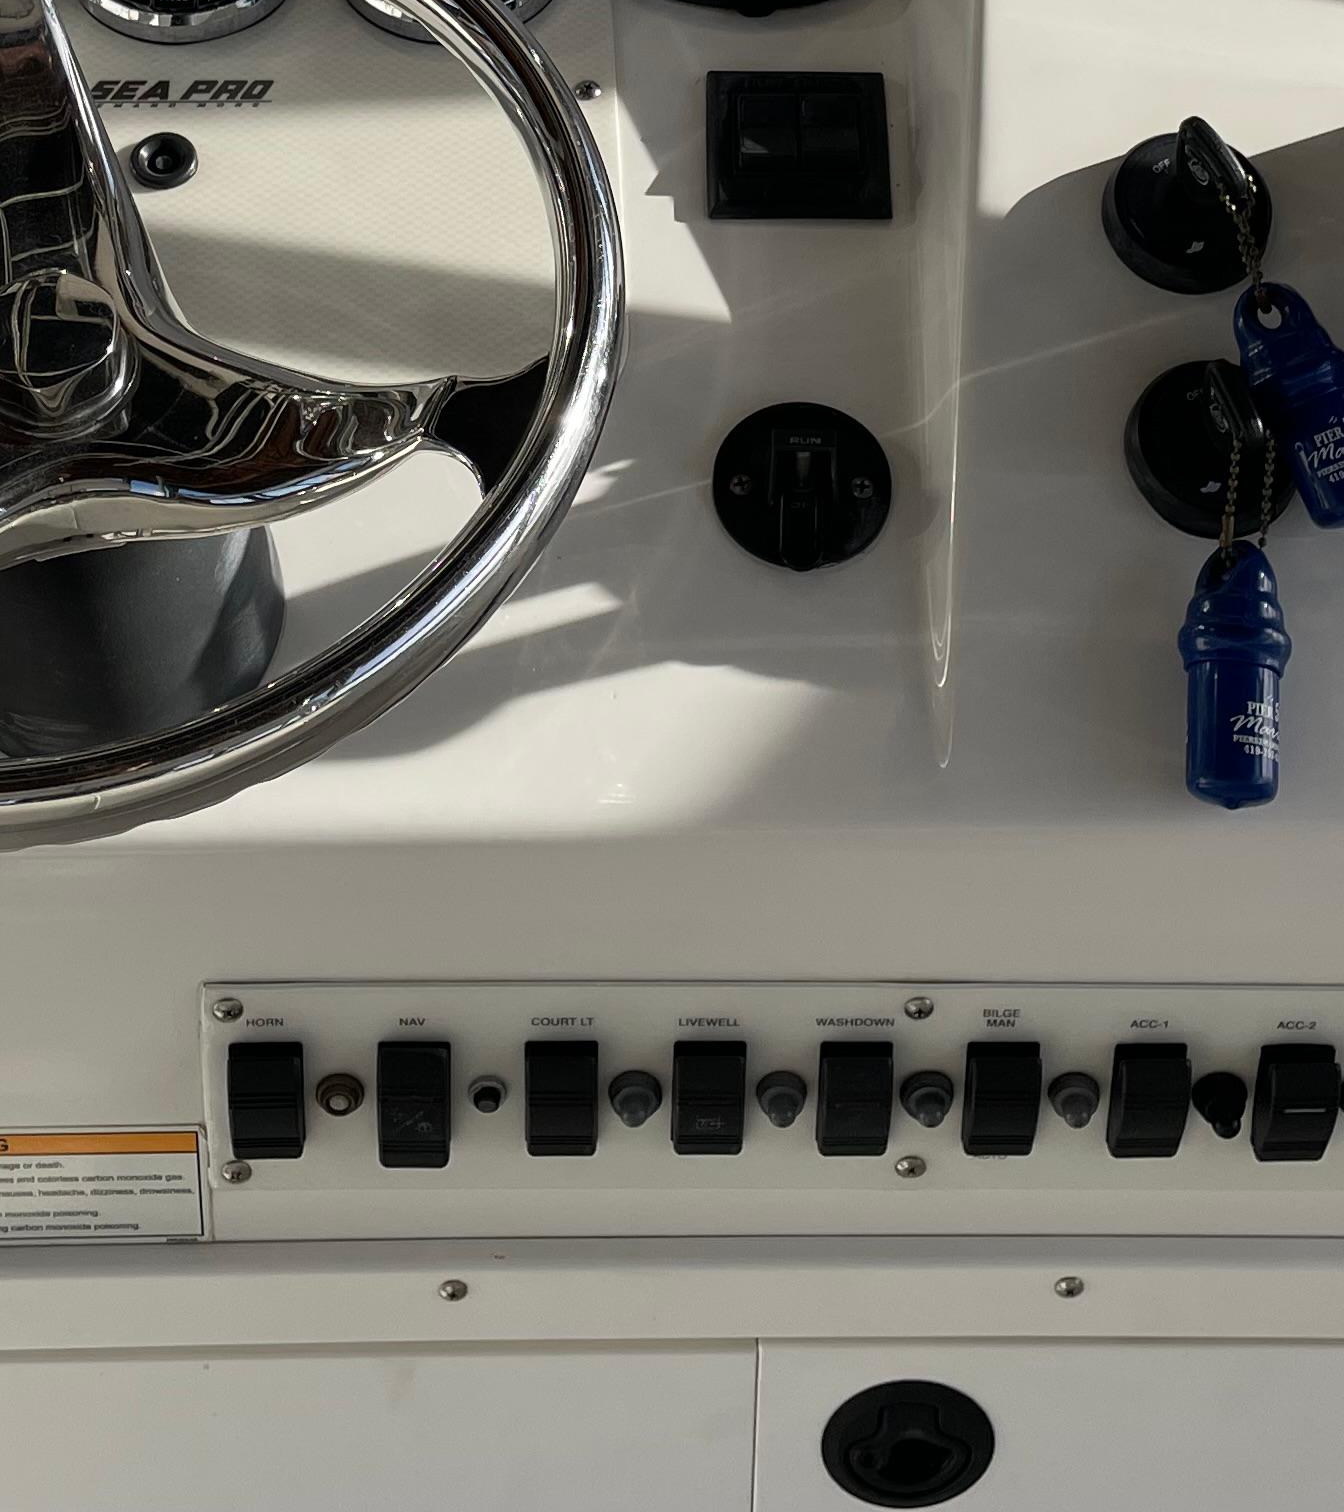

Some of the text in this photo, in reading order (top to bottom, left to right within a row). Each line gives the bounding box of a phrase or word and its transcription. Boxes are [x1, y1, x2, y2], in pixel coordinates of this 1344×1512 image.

[91, 80, 275, 100] SEA PRO
[1151, 158, 1171, 174] OFF
[789, 436, 822, 445] RUN
[1313, 426, 1344, 448] PIER
[983, 1008, 1021, 1018] BILGE
[246, 1017, 284, 1027] HORN
[399, 1017, 426, 1027] NAV
[530, 1017, 595, 1027] COURT LT
[678, 1018, 741, 1027] LIVEWELL
[815, 1018, 896, 1027] WASHDOWN
[986, 1018, 1017, 1028] MAN
[1130, 1019, 1169, 1029] ACC-1
[1276, 1020, 1317, 1030] ACC-2
